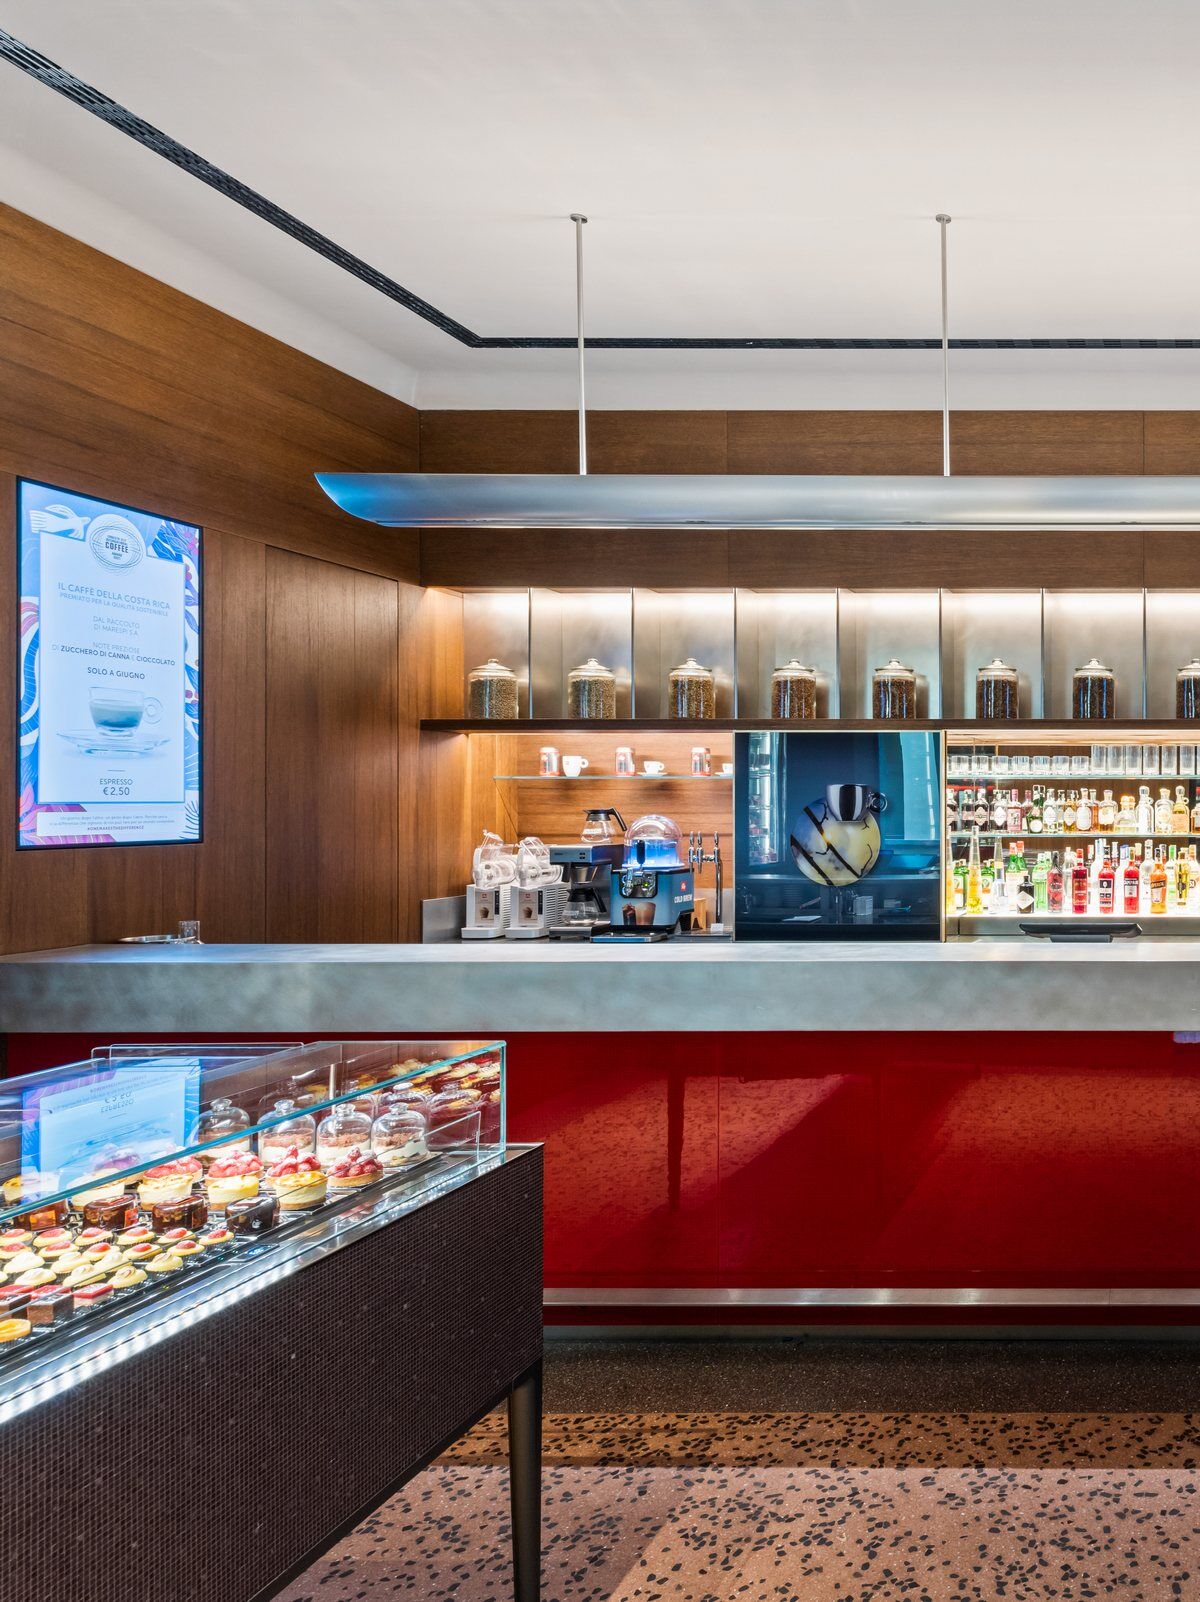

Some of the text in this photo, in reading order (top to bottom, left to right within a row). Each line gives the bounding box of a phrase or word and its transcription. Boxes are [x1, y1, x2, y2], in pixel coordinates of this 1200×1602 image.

[105, 541, 129, 554] COFFEE
[58, 582, 66, 591] IL
[96, 589, 123, 601] DELLA
[124, 594, 151, 606] COSTA
[152, 600, 170, 610] RICA
[93, 615, 140, 629] DAL RACCOLTO
[93, 623, 101, 631] DI
[60, 645, 99, 656] ZUCCHERO
[108, 651, 130, 660] CANNA
[136, 655, 176, 667] CIOCCOLATO
[87, 667, 146, 680] SOLO A GIUGNO
[99, 778, 134, 786] ESPRESSO
